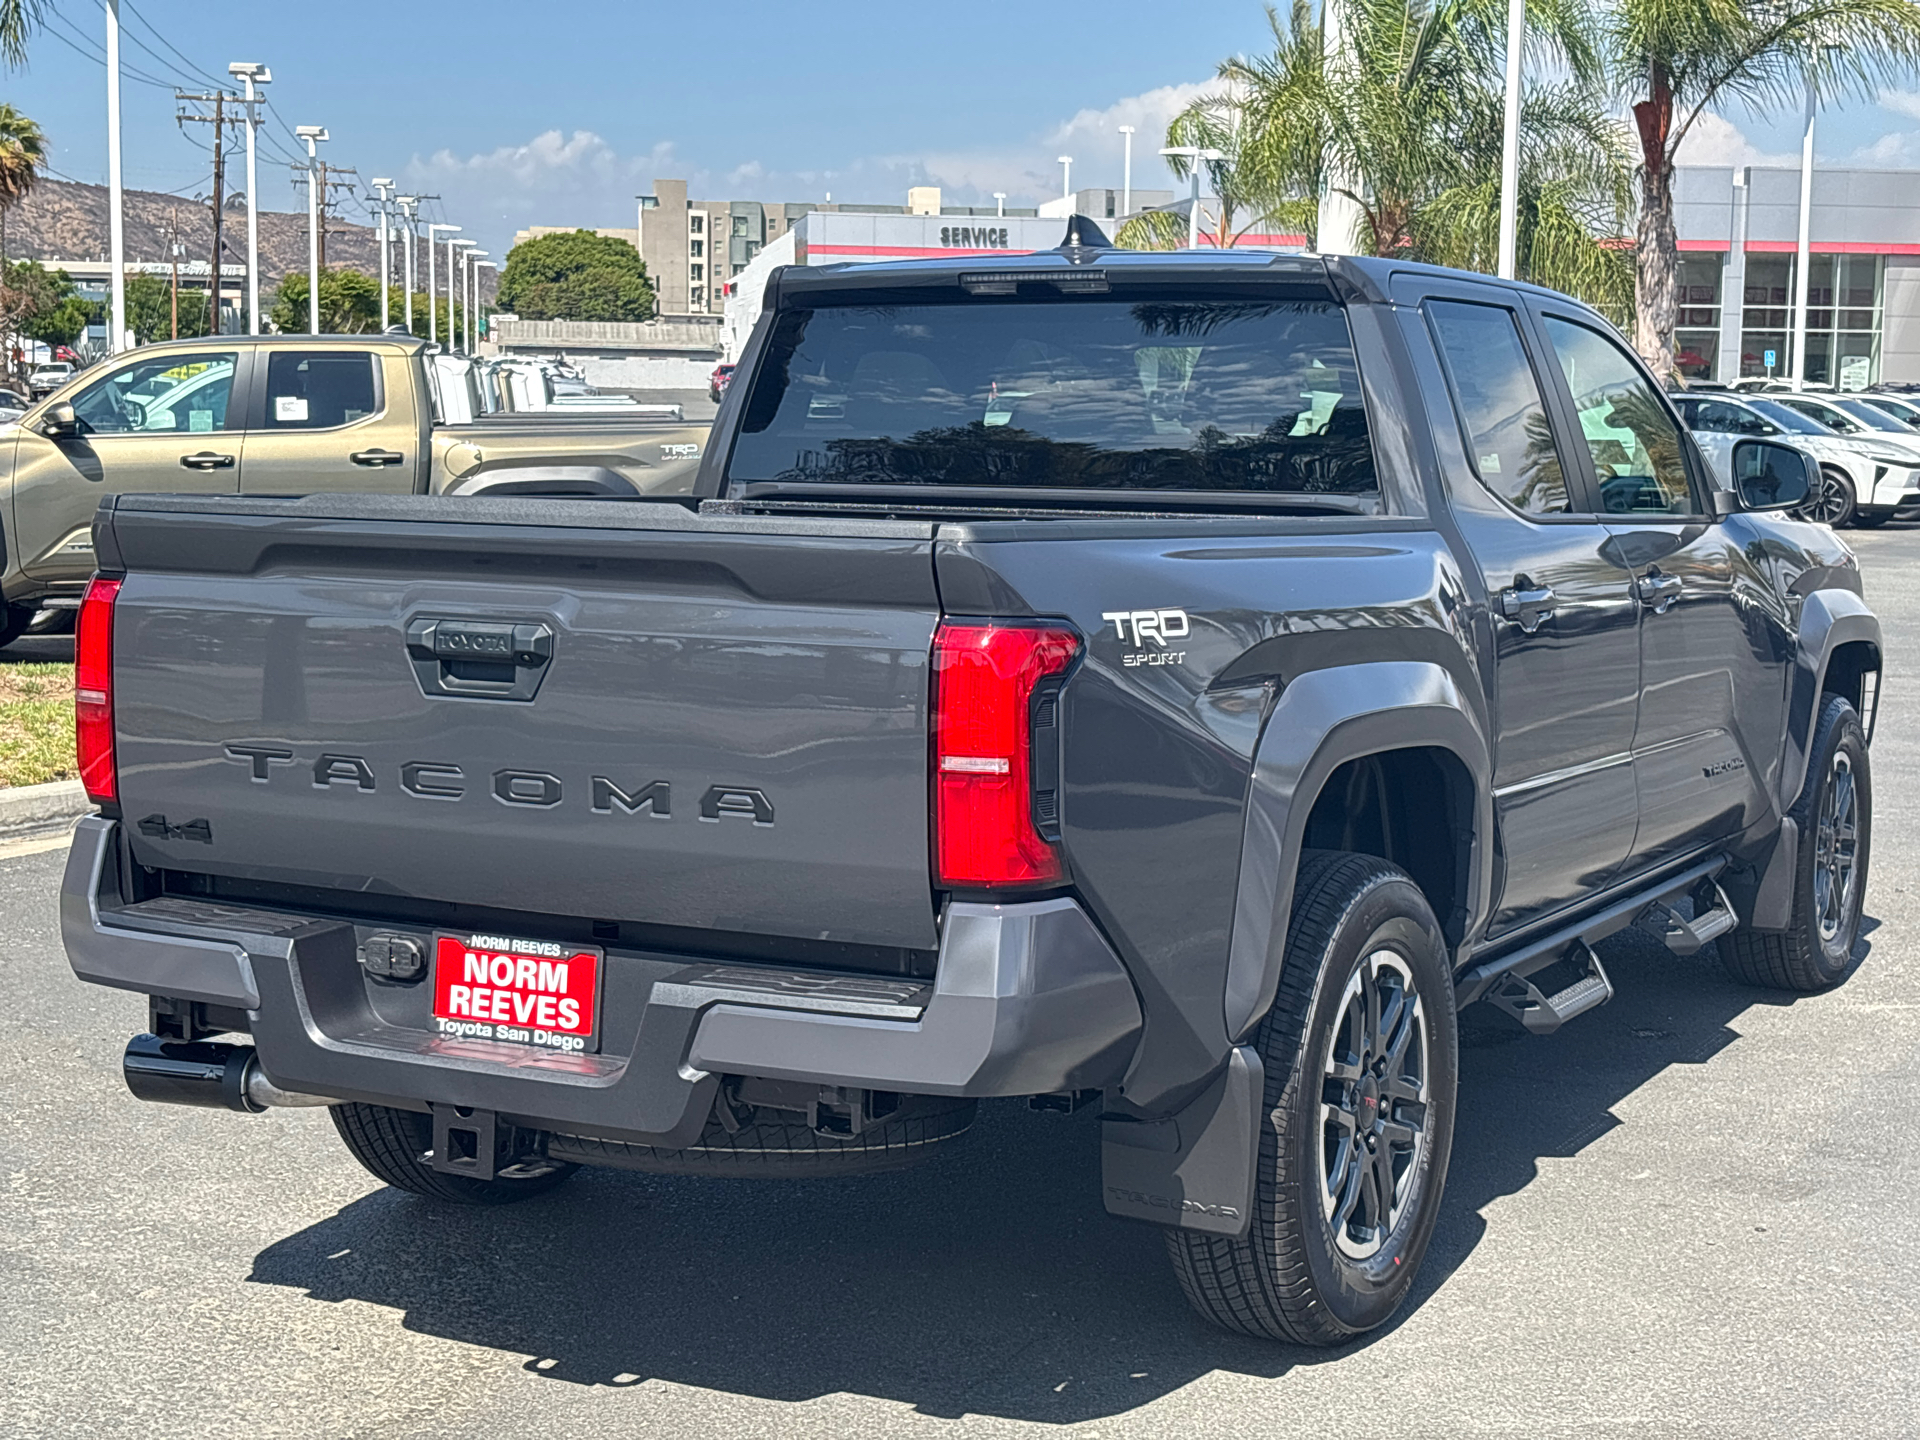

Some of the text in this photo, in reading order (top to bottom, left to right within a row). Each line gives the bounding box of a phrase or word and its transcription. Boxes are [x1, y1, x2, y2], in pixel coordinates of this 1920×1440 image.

[940, 226, 1008, 248] SERVICE
[660, 443, 699, 455] TRD
[438, 632, 508, 652] TOYOTA
[1102, 609, 1189, 648] TRD
[1122, 650, 1186, 667] SPORT
[224, 743, 775, 828] TACOMA
[471, 934, 561, 957] NORM REEVES
[463, 952, 569, 994] NORM
[449, 984, 580, 1029] REEVES
[435, 1017, 584, 1050] Toyota San Diego
[1107, 1186, 1239, 1221] TACOMA
